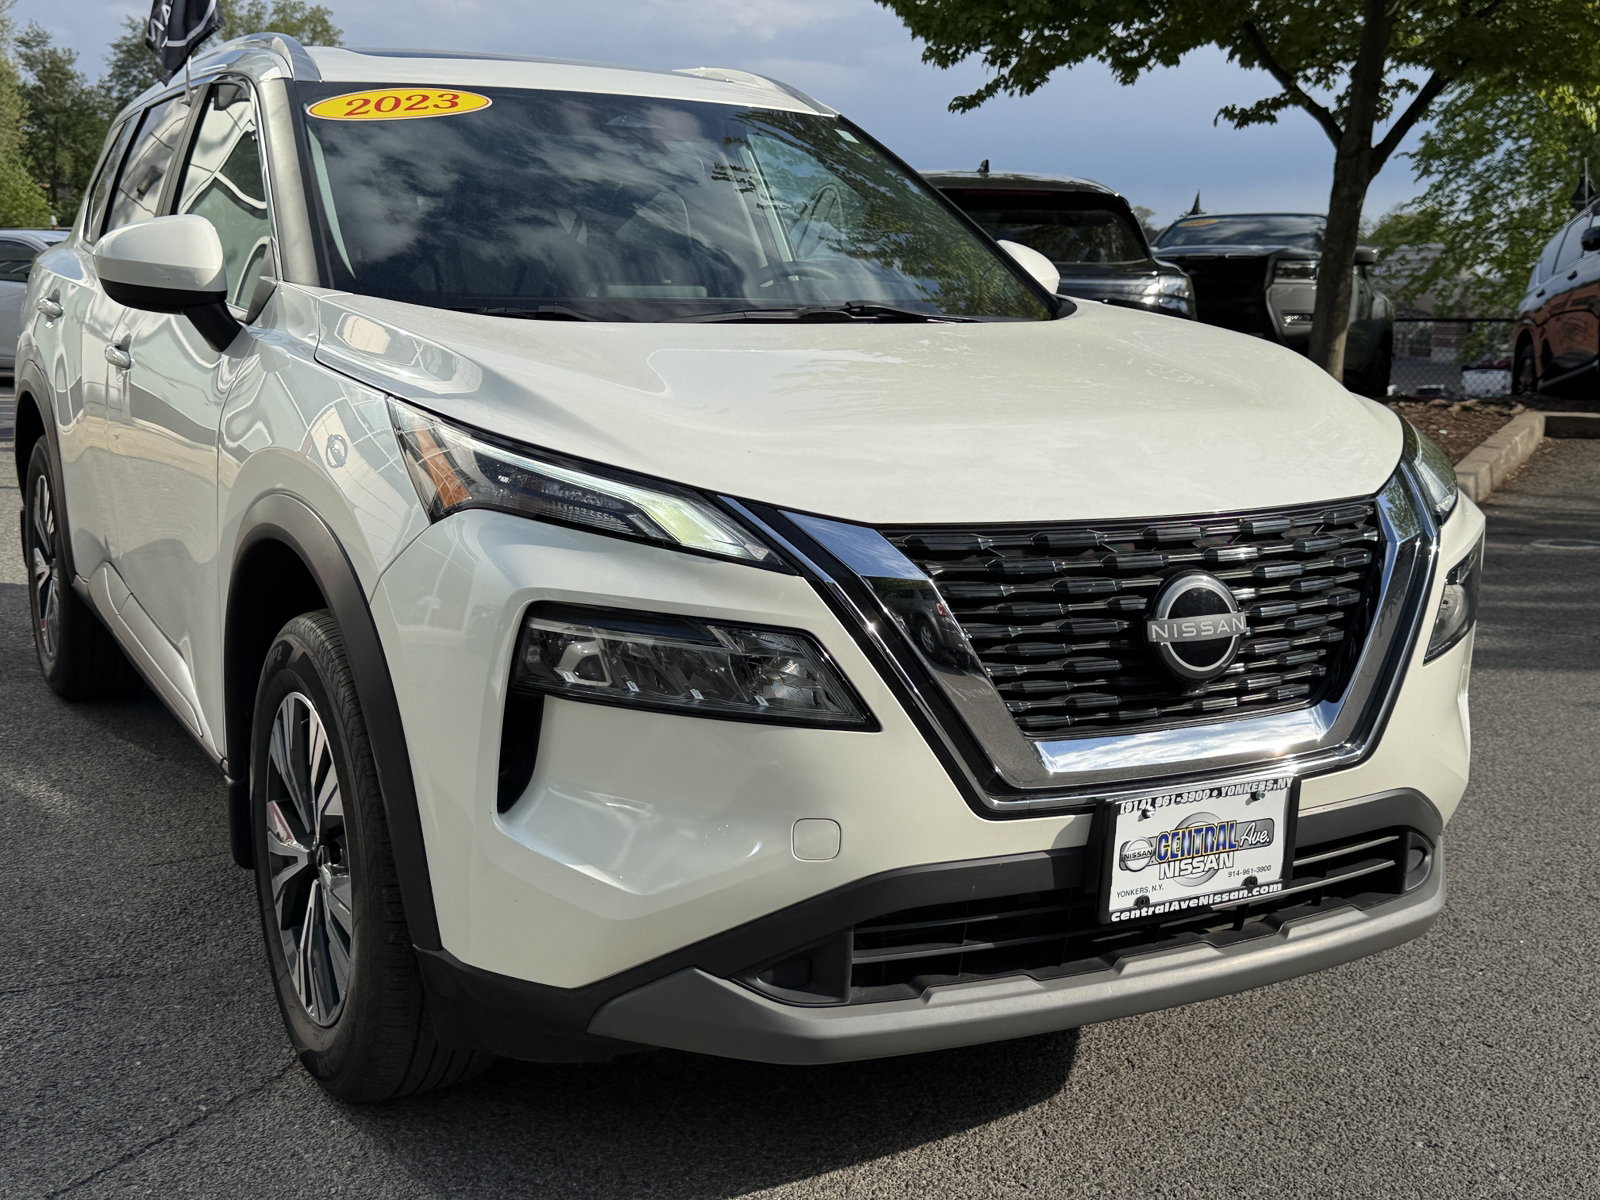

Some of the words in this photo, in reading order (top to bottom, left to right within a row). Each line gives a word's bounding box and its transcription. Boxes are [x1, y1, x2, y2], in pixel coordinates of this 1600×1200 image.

[343, 93, 460, 116] 2023
[1151, 616, 1244, 639] NISSAN
[1155, 789, 1210, 807] 961-3900
[1155, 820, 1239, 863] CENTRAL
[1240, 822, 1270, 847] Ave.
[1122, 849, 1153, 861] NISSAN
[1158, 851, 1234, 880] NISSAN
[1228, 864, 1272, 878] 914-961-3900
[1116, 885, 1151, 898] YONKERS,
[1152, 883, 1164, 893] N.Y.
[1111, 883, 1282, 922] CentralAveNissan.com
